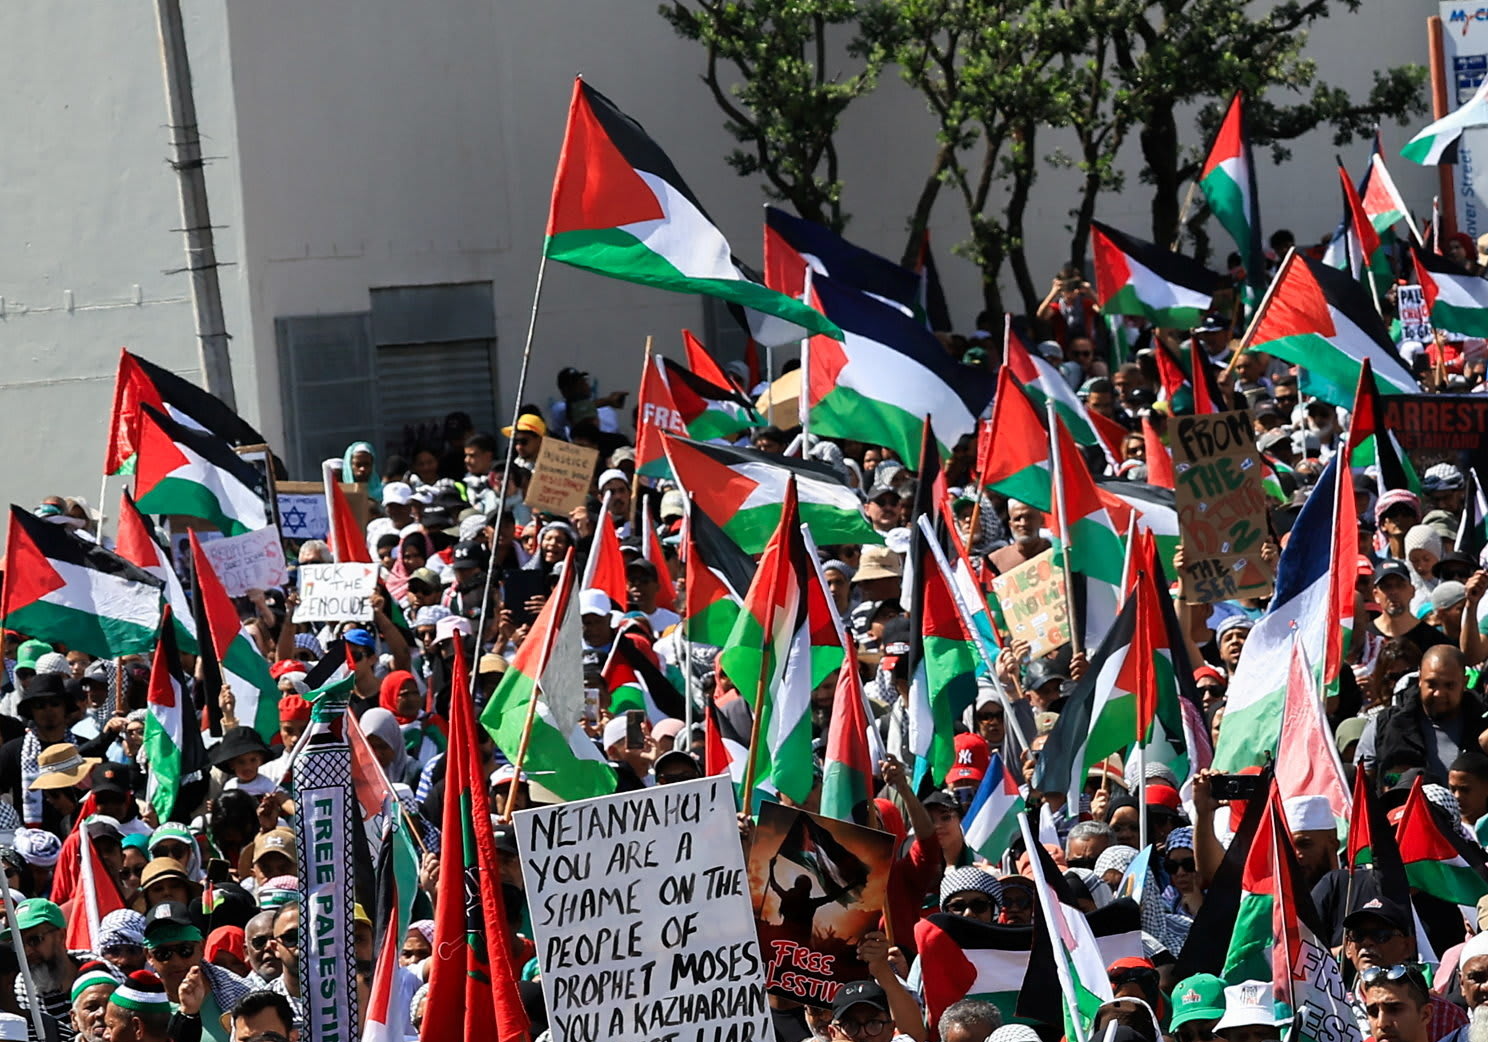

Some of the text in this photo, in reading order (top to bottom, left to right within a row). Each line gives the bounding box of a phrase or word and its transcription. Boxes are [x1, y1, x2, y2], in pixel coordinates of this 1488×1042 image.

[1461, 148, 1473, 197] Street
[643, 402, 688, 434] FRE
[1178, 411, 1254, 463] FROM
[1384, 401, 1488, 432] ARREST
[1178, 457, 1245, 499] THE
[1229, 519, 1261, 553] 2
[303, 566, 345, 581] FUCK
[330, 579, 363, 590] THE
[1187, 559, 1229, 580] THE
[1194, 575, 1238, 600] SEA
[297, 596, 370, 617] GENOCIDE
[313, 797, 336, 885] FREE
[528, 832, 692, 892] YOU ARE A
[540, 865, 743, 926] SHAME ON THE
[545, 912, 699, 973] PEOPLE OF
[771, 940, 836, 975] FREE
[553, 960, 656, 1011] PROPHET
[765, 960, 845, 1004] LESTIN
[608, 1007, 624, 1038] A
[634, 982, 766, 1036] KAZHARIAN
